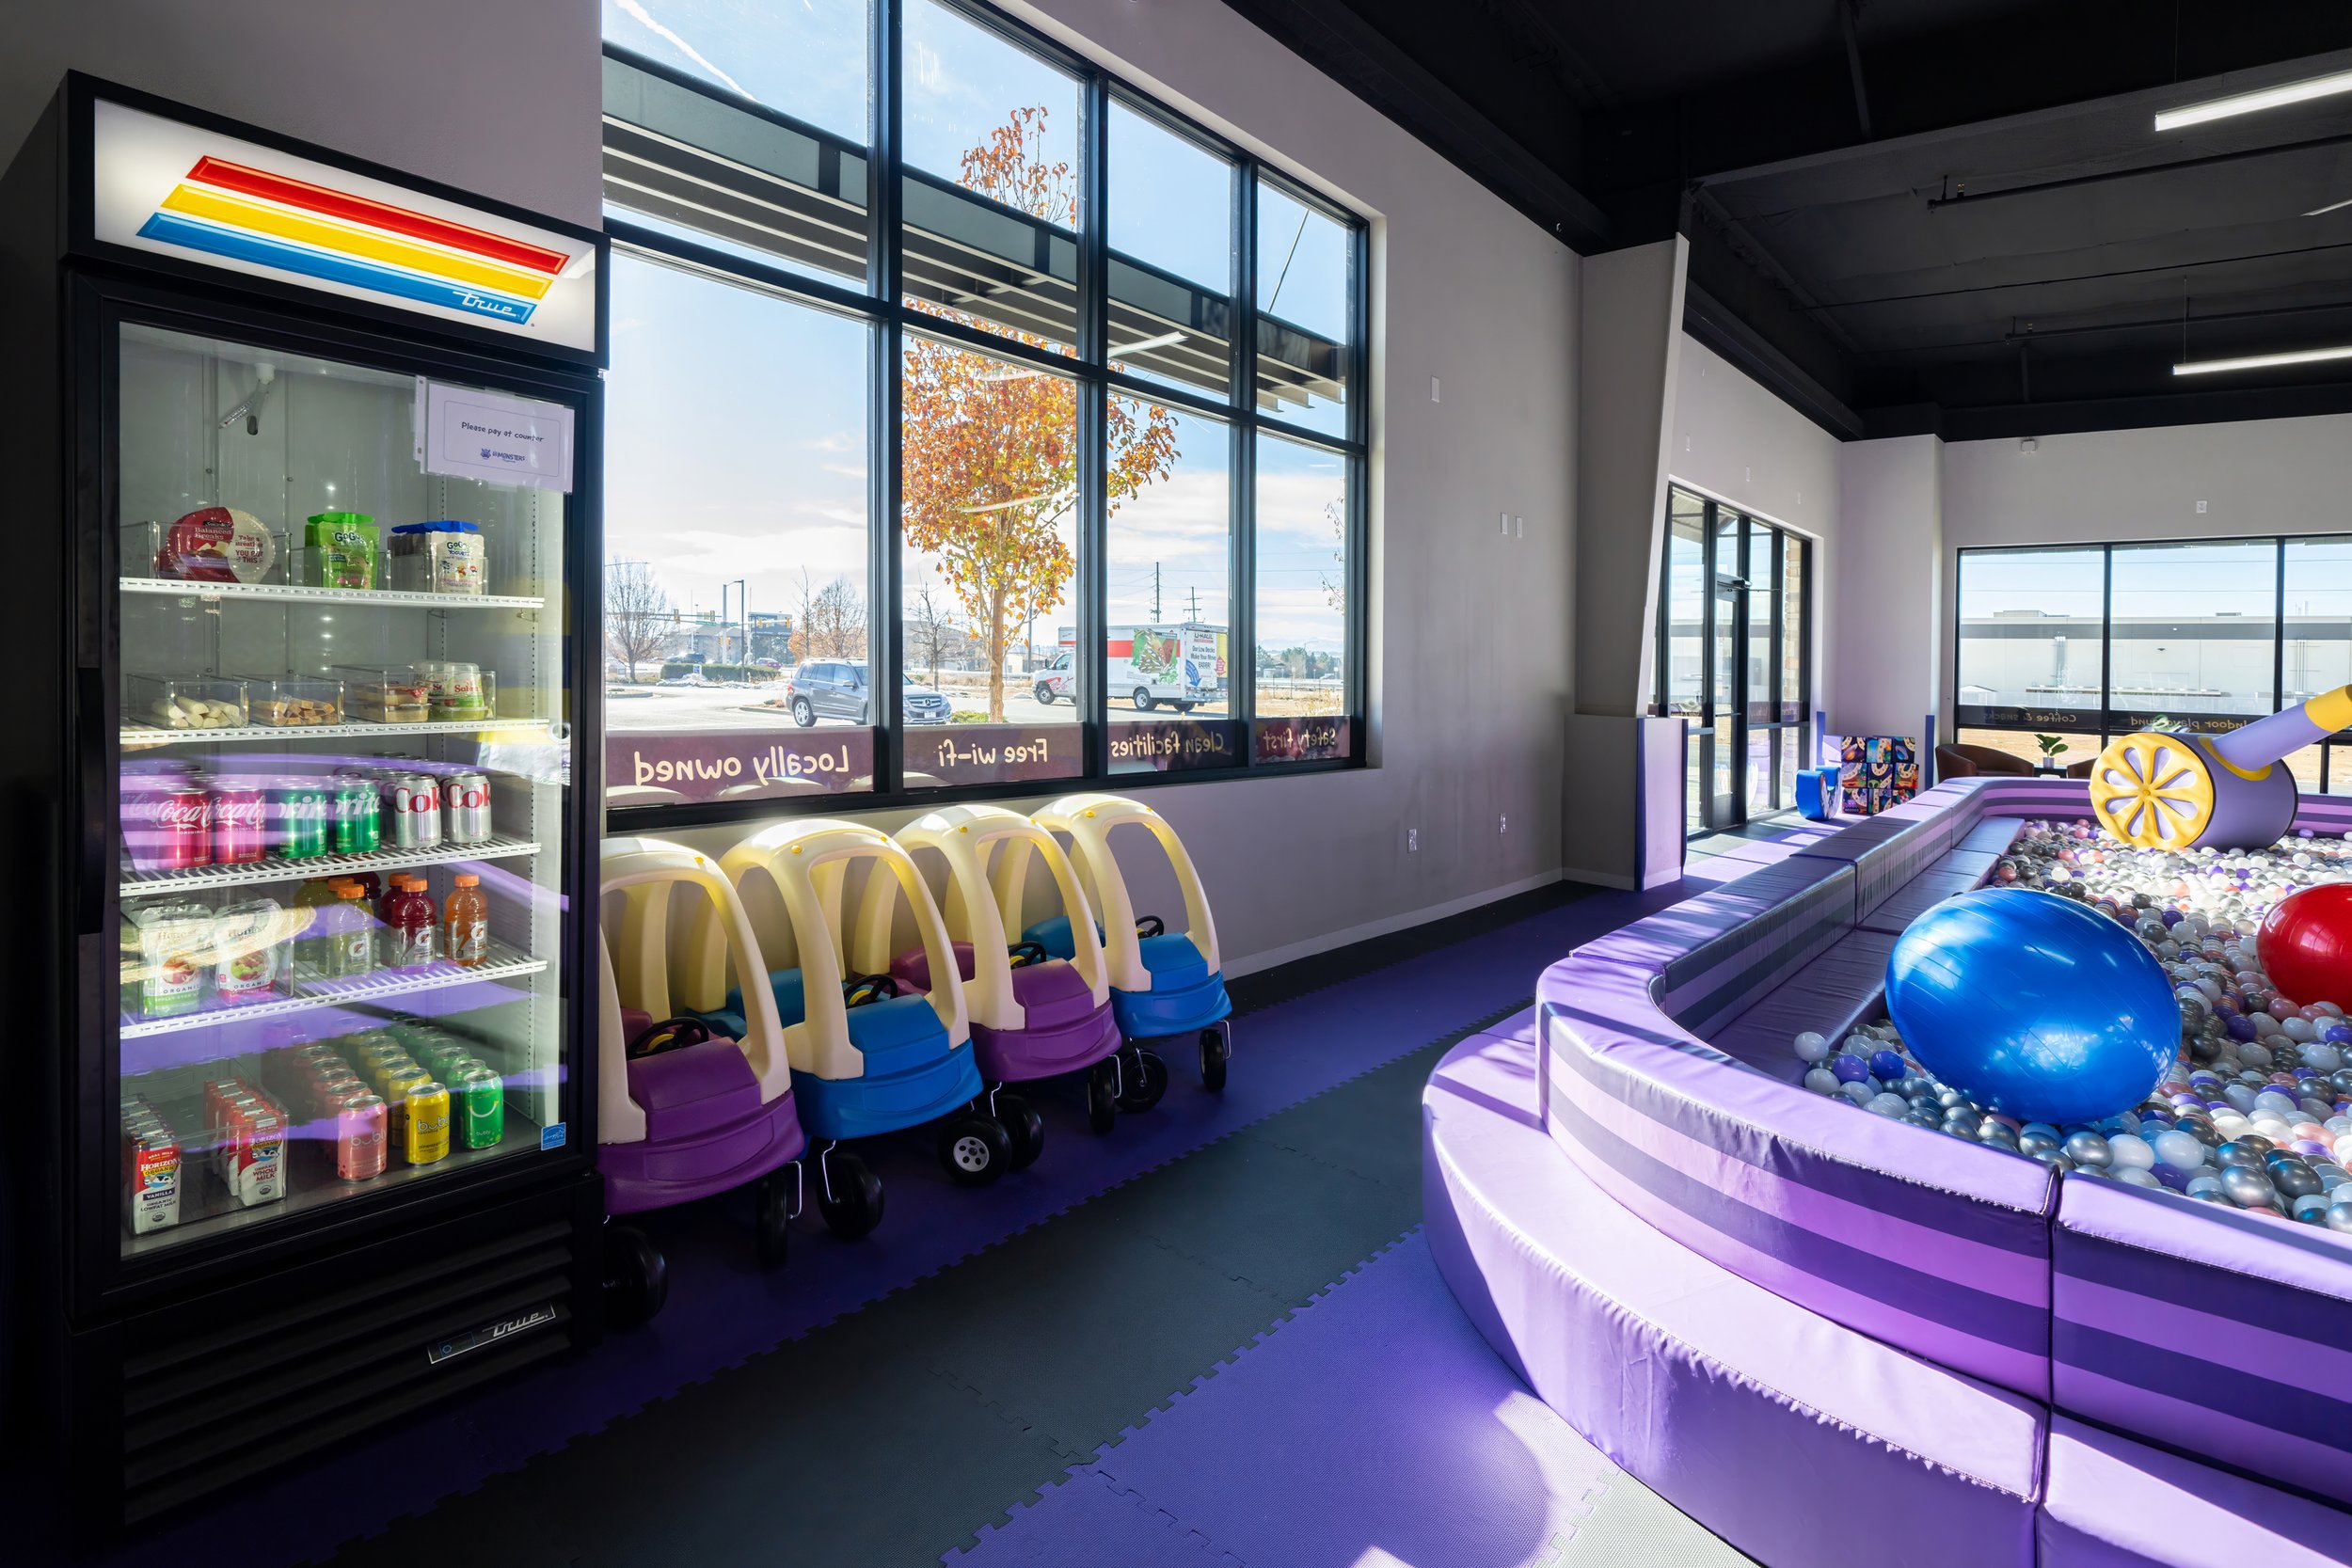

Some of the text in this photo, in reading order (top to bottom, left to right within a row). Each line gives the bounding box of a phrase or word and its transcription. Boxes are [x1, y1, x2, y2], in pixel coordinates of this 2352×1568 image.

[461, 421, 486, 433] Please
[488, 428, 501, 436] pay
[515, 433, 544, 442] counter
[394, 786, 440, 814] Cok
[447, 783, 491, 809] Cok
[417, 1114, 450, 1132] bubl
[141, 1158, 178, 1172] HORIZON
[252, 1166, 278, 1176] WHOLE
[147, 1190, 173, 1199] VANILLA
[141, 1204, 164, 1212] LOWFAT
